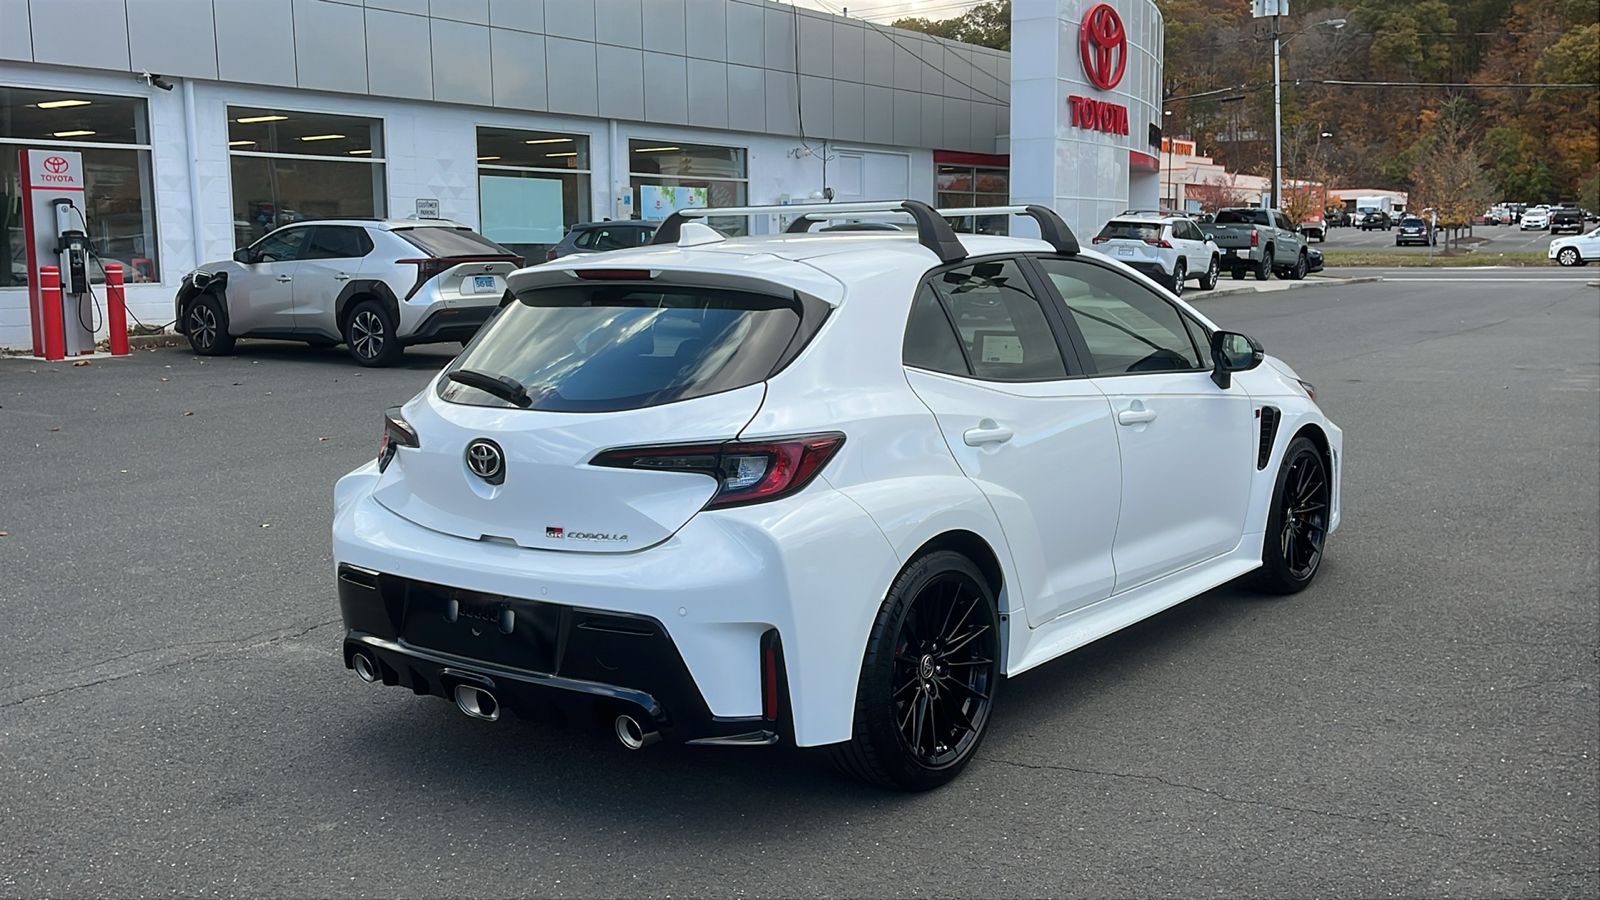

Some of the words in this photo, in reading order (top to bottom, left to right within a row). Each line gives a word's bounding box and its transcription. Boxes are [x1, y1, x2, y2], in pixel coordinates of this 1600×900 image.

[1068, 94, 1130, 137] TOYOTA
[40, 174, 74, 183] TOYOTA
[567, 531, 628, 542] COROLLA
